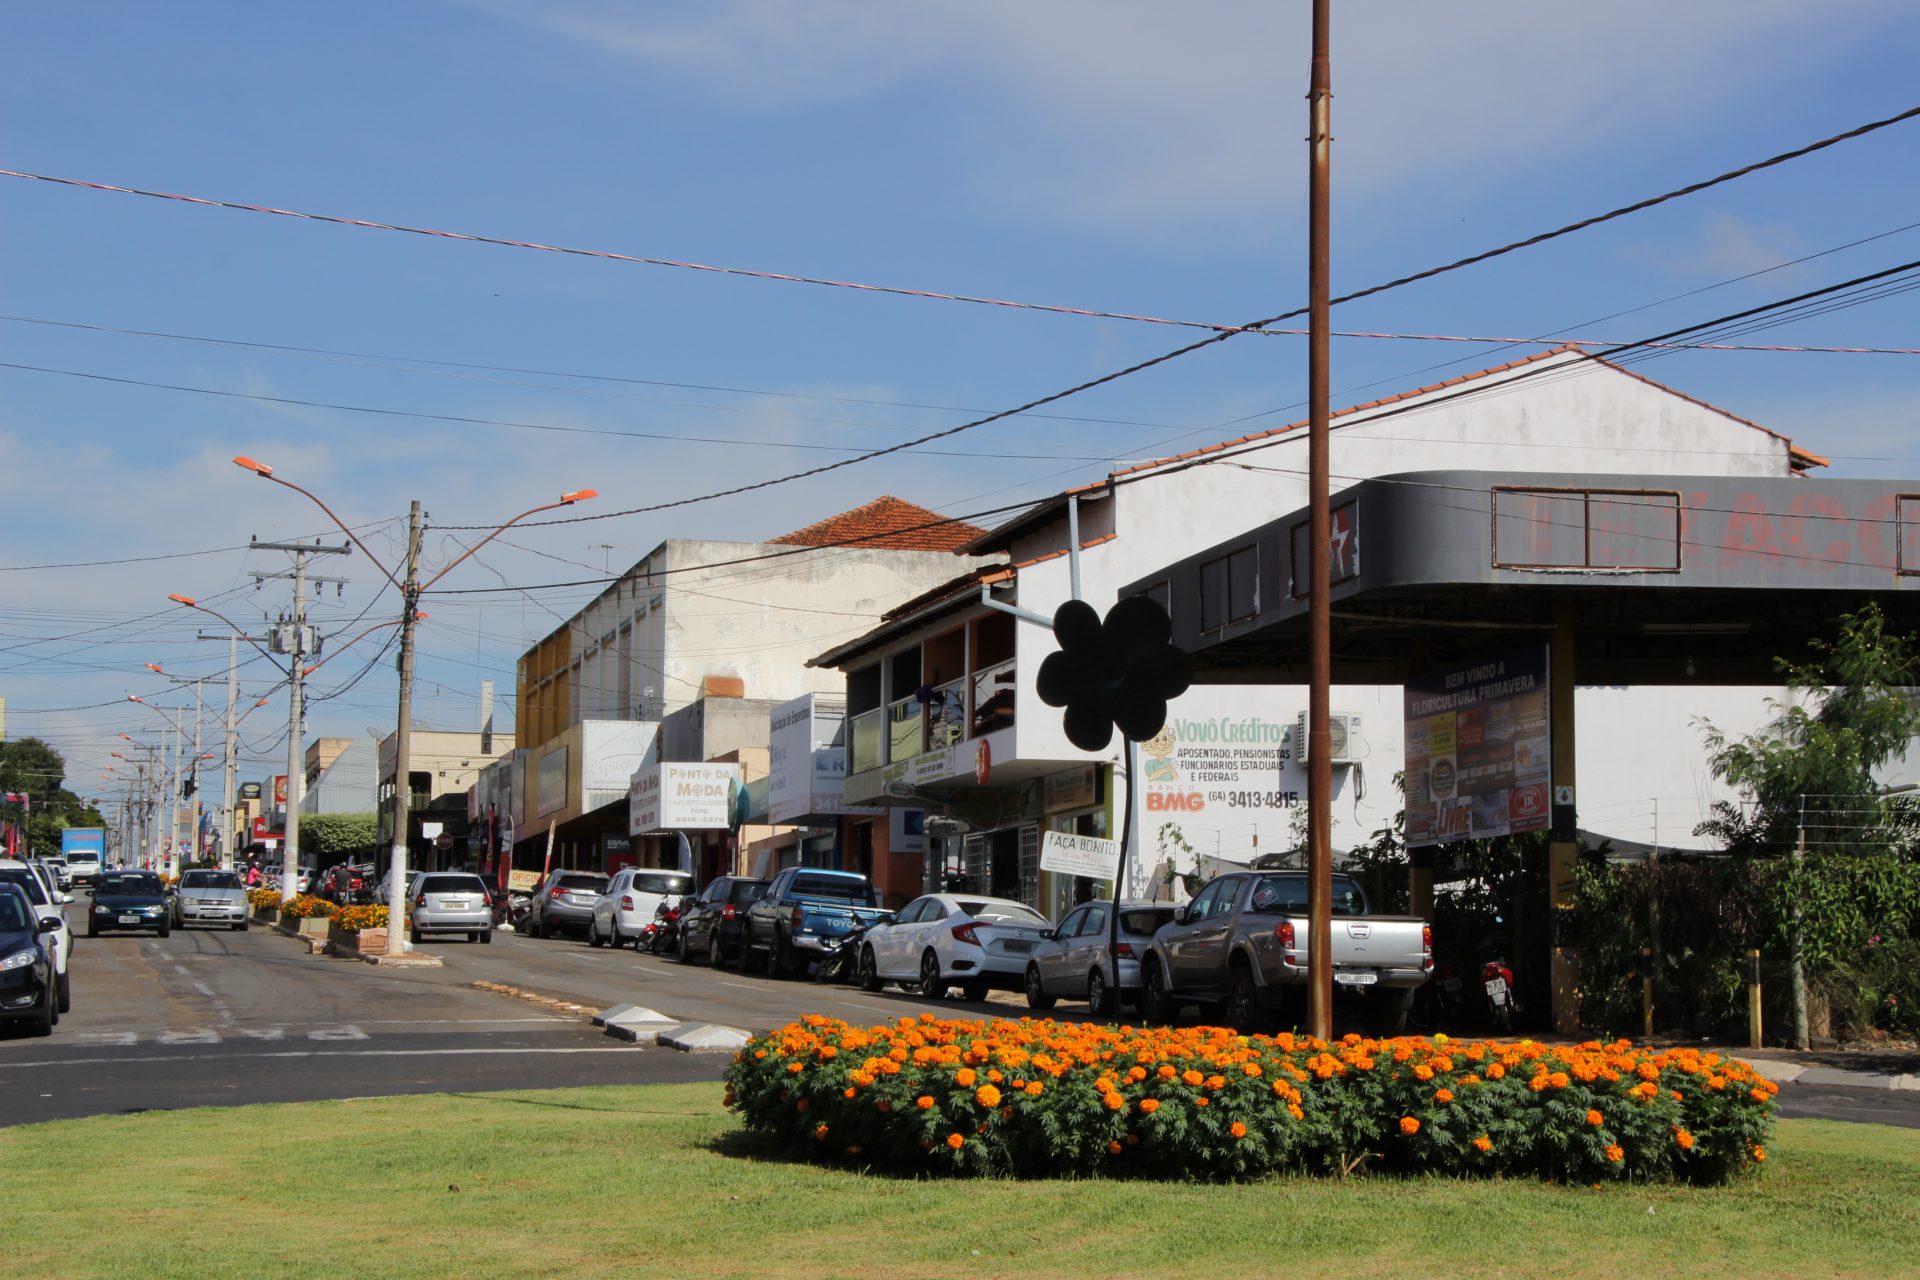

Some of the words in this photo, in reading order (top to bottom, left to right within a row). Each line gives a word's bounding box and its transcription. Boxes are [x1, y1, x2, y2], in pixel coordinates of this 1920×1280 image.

[1445, 673, 1464, 689] BEM
[1466, 663, 1496, 683] VINDO
[1498, 661, 1505, 677] A
[1412, 690, 1477, 717] FLORICULTURA
[1479, 674, 1535, 701] PRIMAVERA
[1220, 716, 1291, 744] Créditos
[1177, 749, 1233, 760] APOSENTADO,
[1233, 749, 1291, 760] PENSIONISTAS
[1240, 761, 1285, 771] ESTADUAIS
[715, 769, 730, 779] DA
[1190, 772, 1196, 782] E
[1198, 772, 1239, 782] FEDERAIS
[676, 783, 724, 797] MODA
[1146, 792, 1205, 812] BMG
[1208, 790, 1226, 803] (64)
[1049, 833, 1076, 850] FAÇA
[512, 872, 540, 884] OFICIN
[826, 918, 853, 929] TOYO
